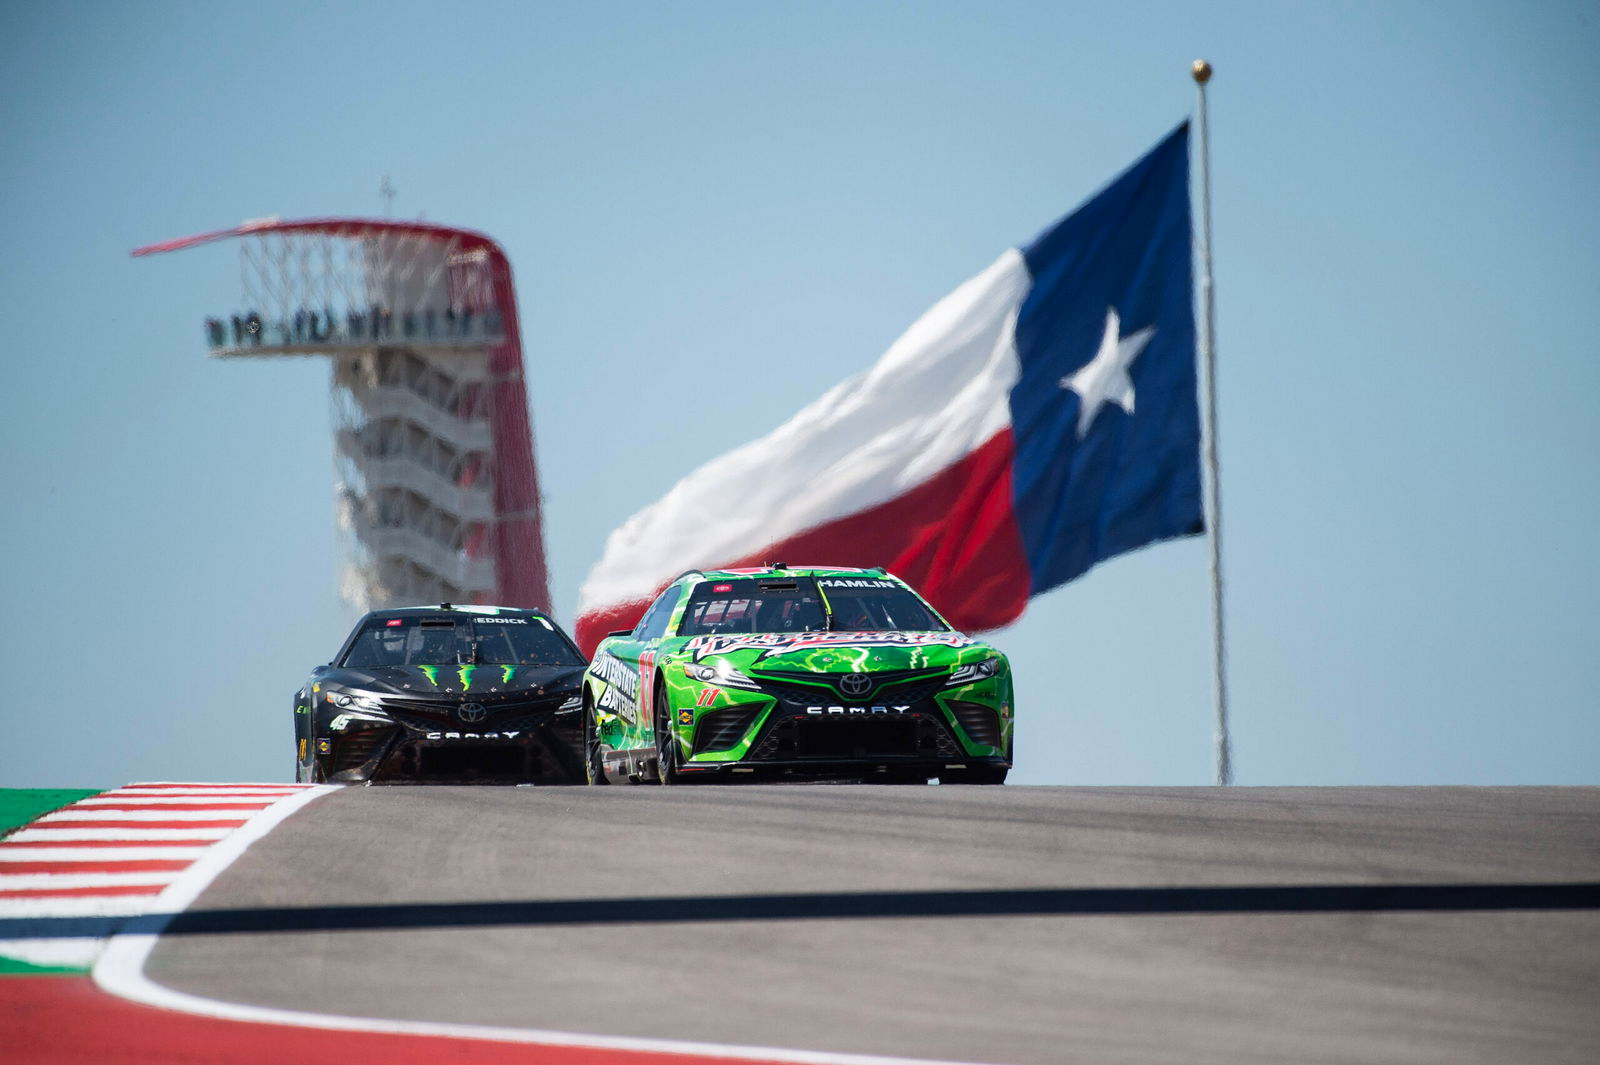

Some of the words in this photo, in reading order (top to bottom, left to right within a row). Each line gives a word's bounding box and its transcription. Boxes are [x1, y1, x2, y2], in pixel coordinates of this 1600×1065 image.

[819, 579, 896, 589] HAMLIN
[591, 651, 637, 700] INTERSTATE
[599, 683, 637, 725] BATTERIES
[696, 688, 721, 707] 11
[806, 705, 910, 715] CAMRY
[426, 731, 520, 739] CAMRY
